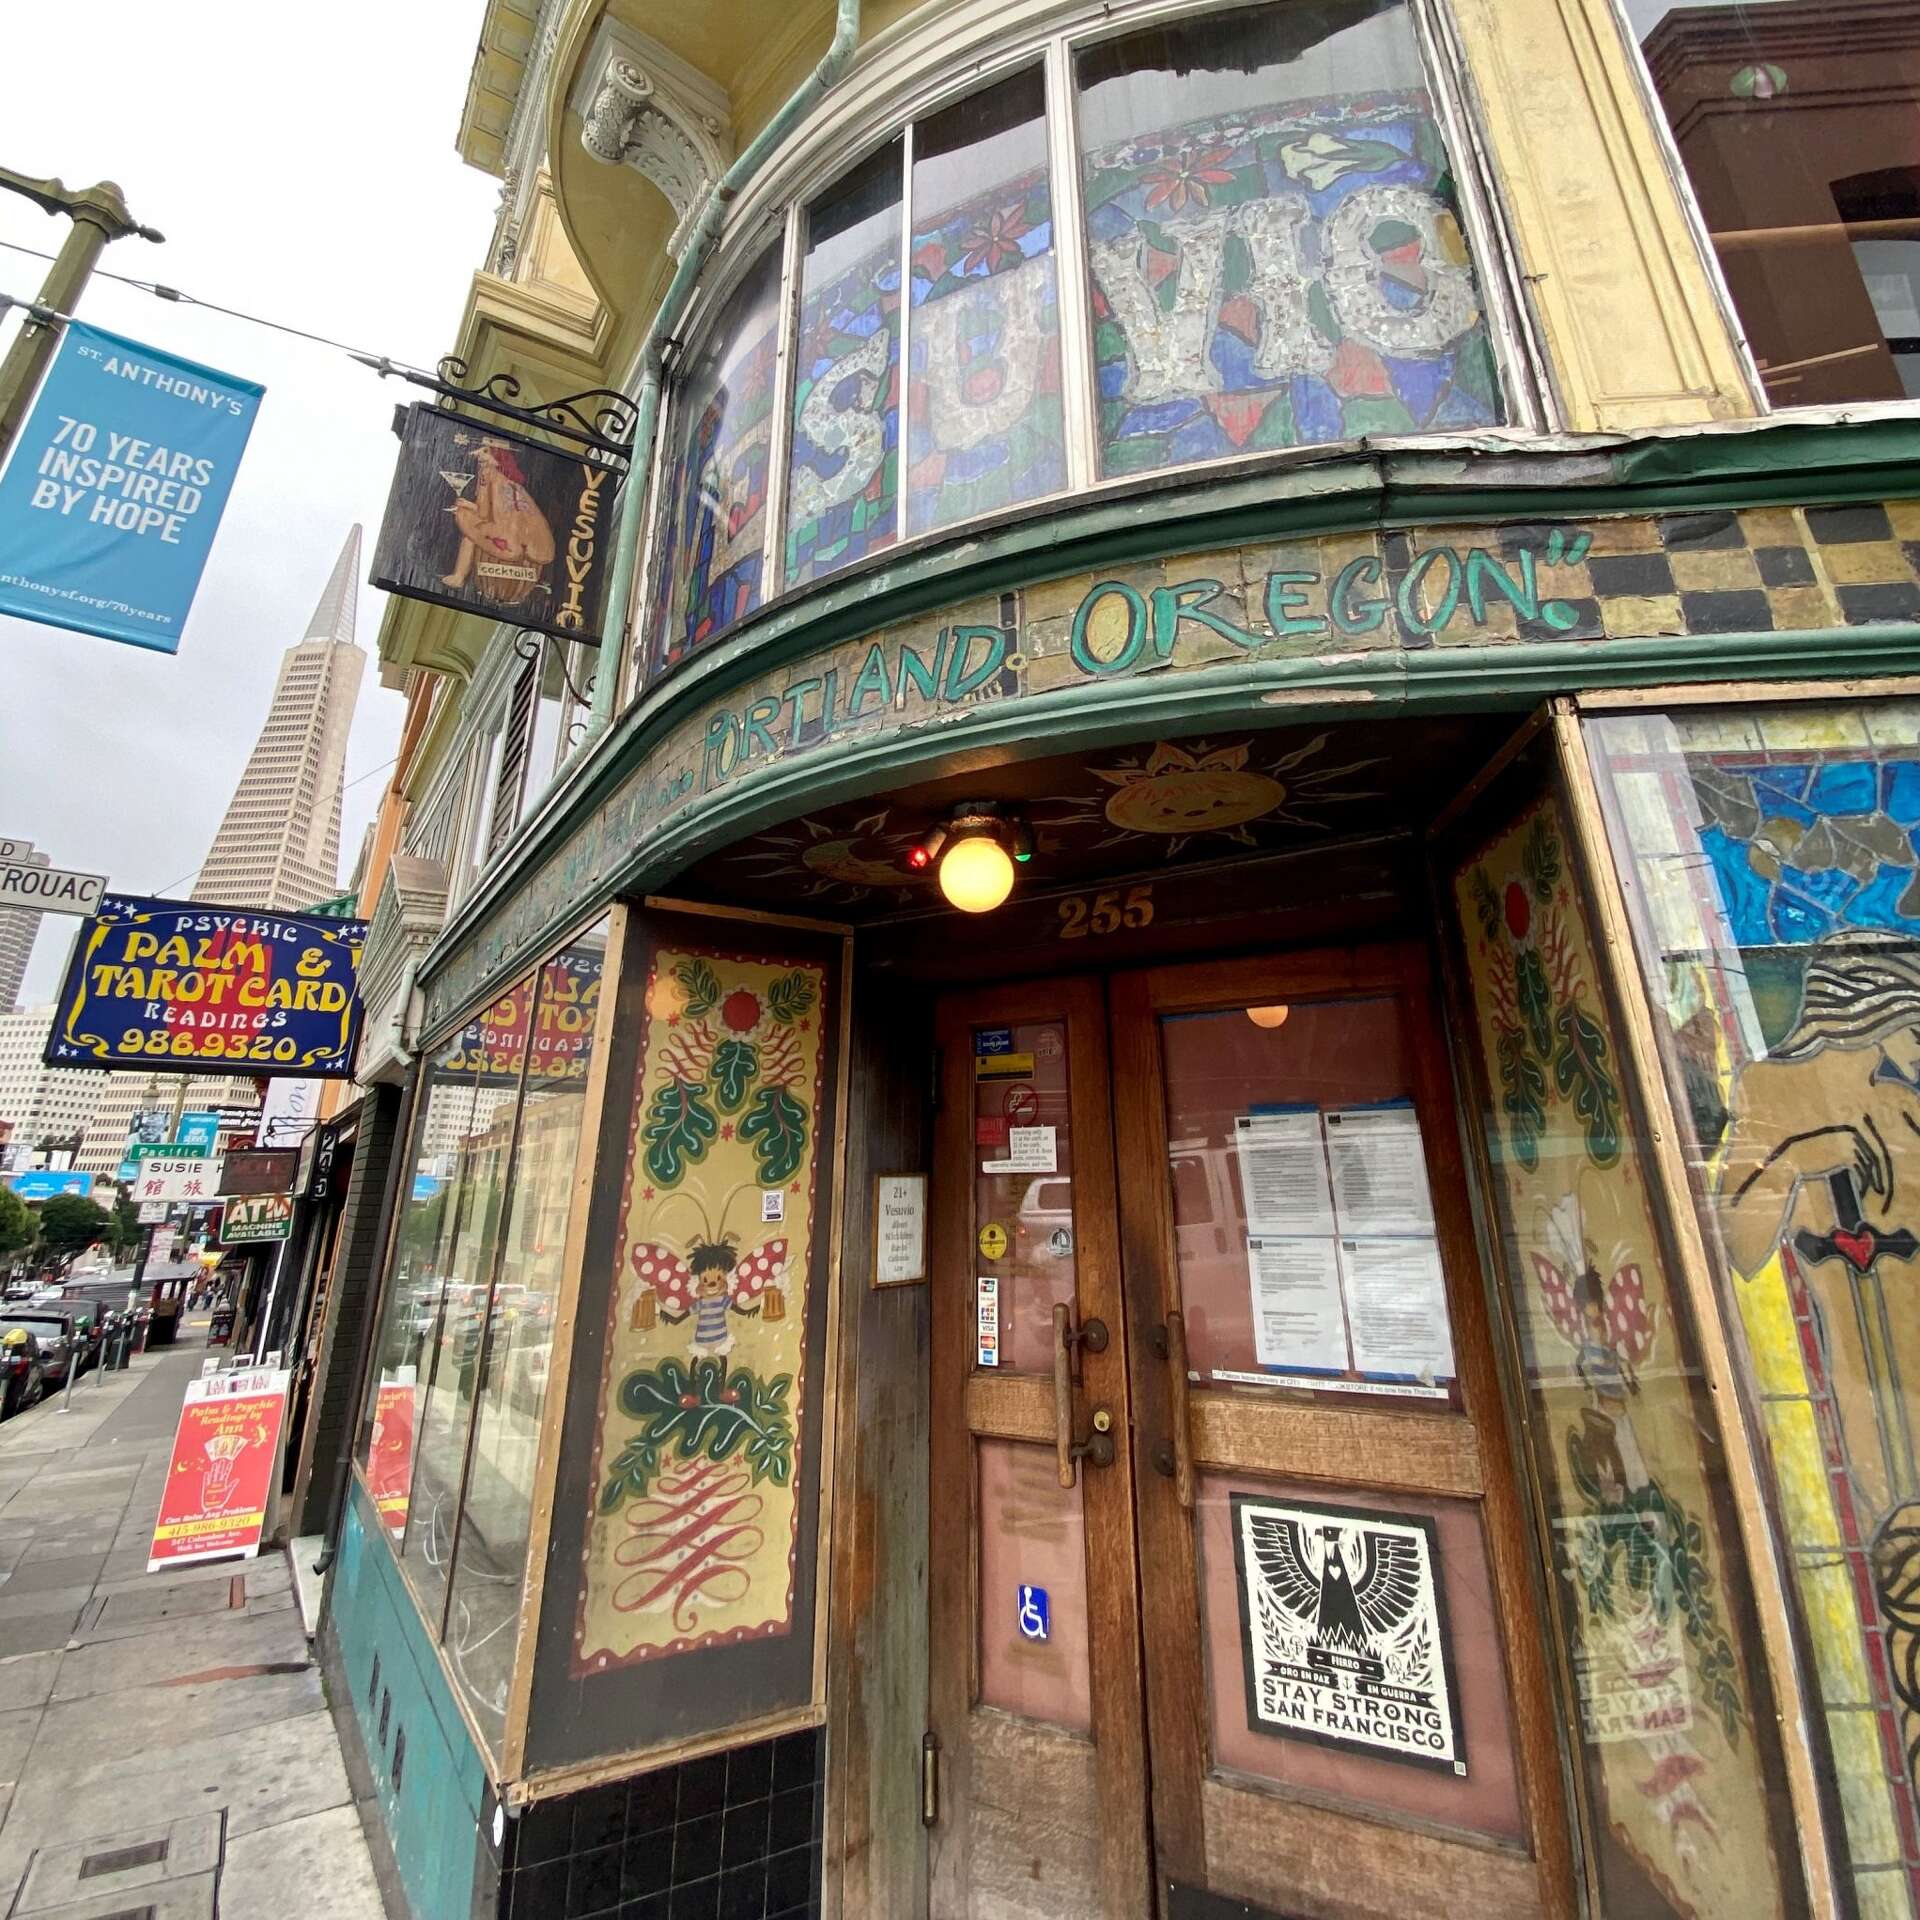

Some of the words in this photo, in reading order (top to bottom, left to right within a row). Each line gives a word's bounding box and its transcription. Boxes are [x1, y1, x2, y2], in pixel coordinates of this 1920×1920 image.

[77, 344, 103, 363] ST.
[103, 357, 243, 416] ANTHONY'S
[51, 416, 97, 453] 70
[108, 431, 214, 487] YEARS
[37, 446, 203, 515] INSPIRED
[30, 480, 87, 515] BY
[89, 495, 188, 544] HOPE
[556, 464, 608, 631] VESUVIO
[480, 566, 534, 580] cocktails
[0, 573, 173, 624] nthonysf.org/70years
[1058, 884, 1154, 939] 255
[175, 916, 297, 942] PSYCHIC
[122, 932, 265, 973] PALM
[295, 947, 332, 977] &
[92, 964, 234, 1005] TAROT
[238, 975, 346, 1012] CARD
[144, 1002, 287, 1028] READINGS
[118, 1028, 297, 1061] 986.9320
[138, 1147, 200, 1158] Pacific
[150, 1162, 203, 1174] SUSIE
[227, 1198, 290, 1224] ATM
[231, 1222, 283, 1231] MACHINE
[885, 1204, 915, 1216] Vesuvio
[226, 1229, 286, 1239] AVAILABLE
[1280, 1667, 1299, 1679] ORO
[1262, 1678, 1322, 1706] STAY
[1332, 1692, 1442, 1730] STRONG
[1381, 1685, 1418, 1703] GUERRA
[1263, 1697, 1306, 1721] SAN
[1313, 1708, 1446, 1750] FRANCISCO
